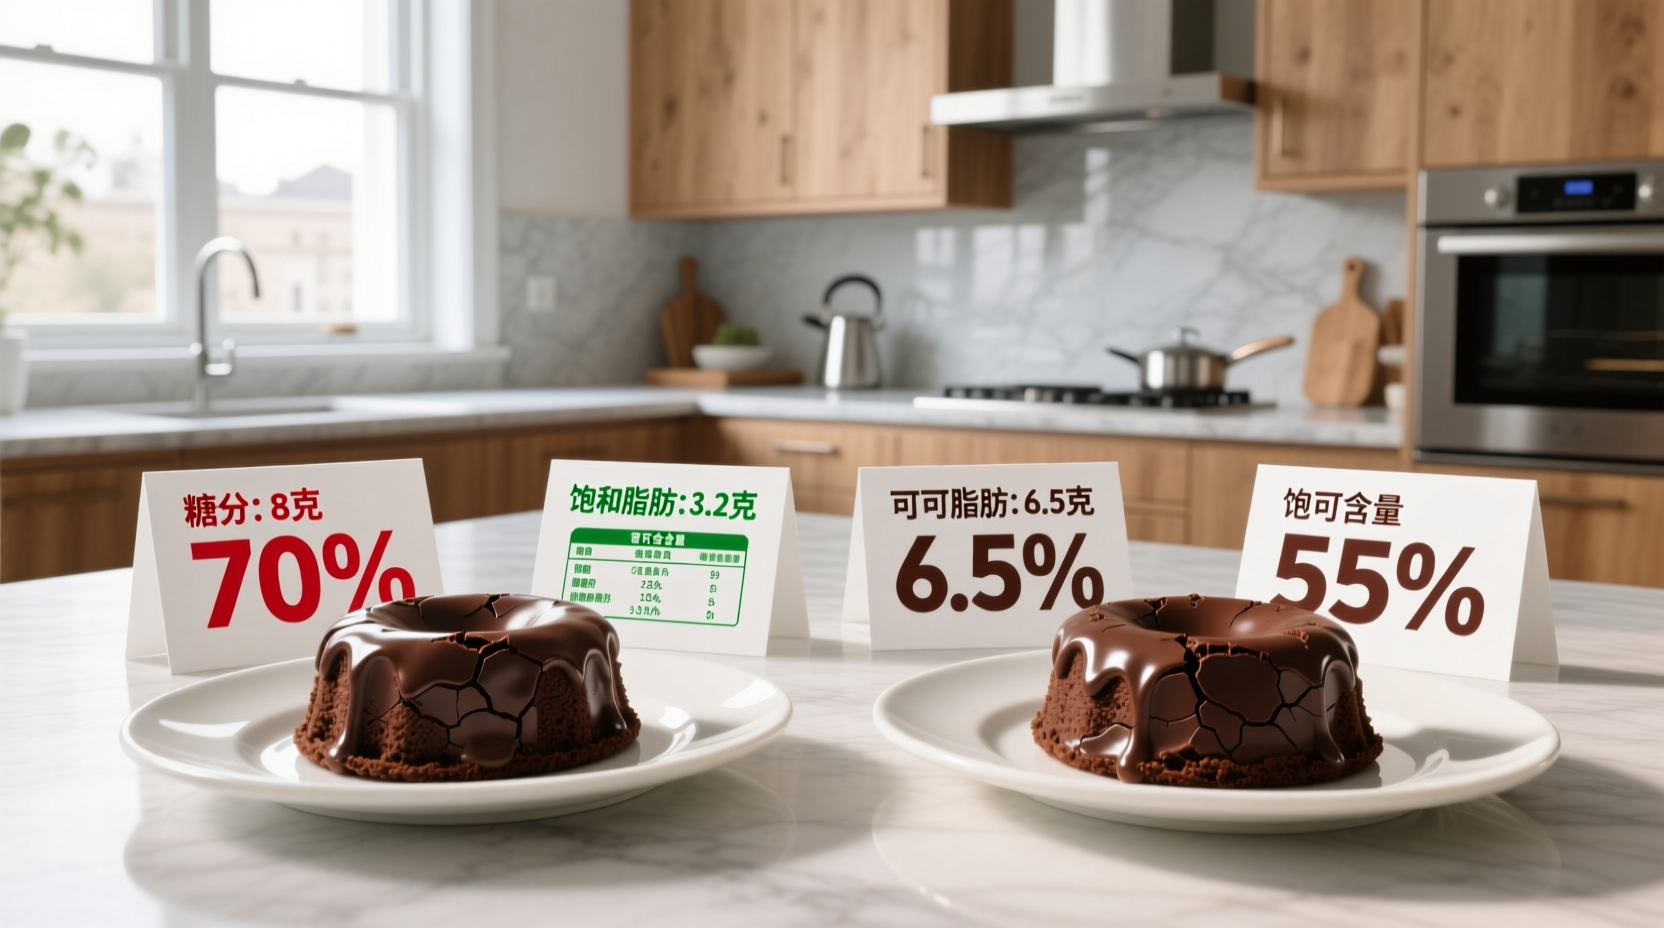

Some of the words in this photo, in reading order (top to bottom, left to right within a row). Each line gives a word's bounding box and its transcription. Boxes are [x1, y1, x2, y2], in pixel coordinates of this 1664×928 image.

[570, 484, 758, 521] 饱和脂肪:3.2克
[890, 485, 1095, 520] 可可脂肪:6.5克
[1283, 487, 1404, 526] 饱可含量
[190, 530, 416, 629] 70%
[896, 533, 1104, 613] 6.5%
[1270, 533, 1485, 637] 55%
